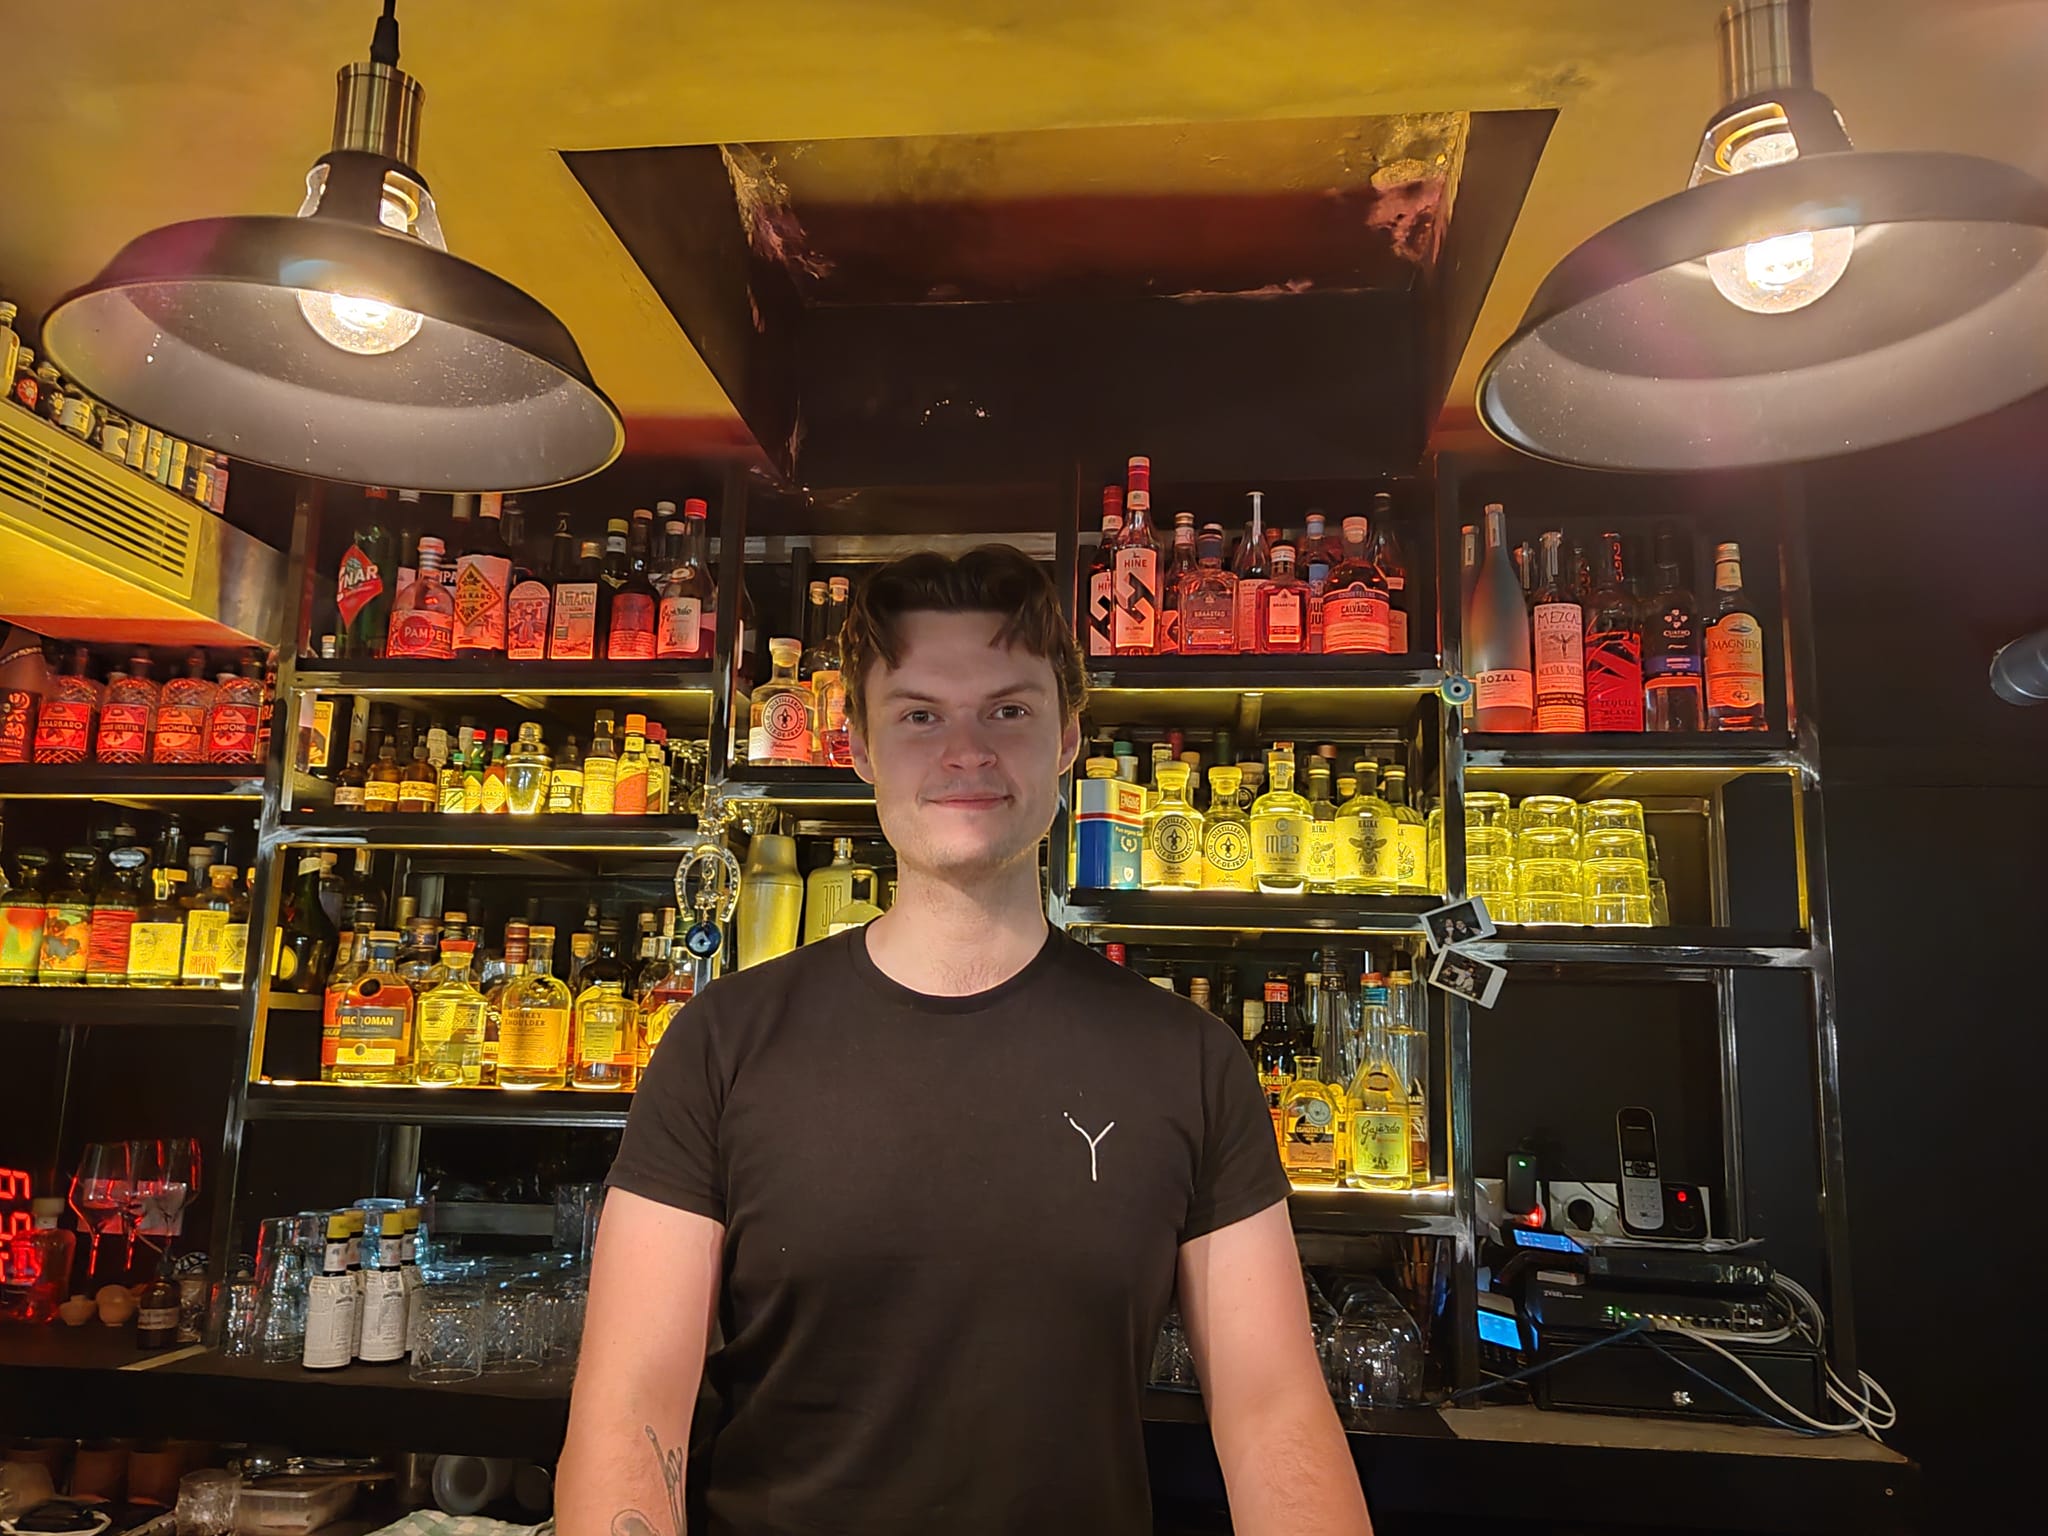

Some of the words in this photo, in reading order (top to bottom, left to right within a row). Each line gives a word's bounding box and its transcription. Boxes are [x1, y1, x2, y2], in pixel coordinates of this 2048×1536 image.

[1124, 560, 1147, 568] HINE
[1341, 604, 1374, 614] CALVADOS
[1538, 610, 1581, 626] MEZCAL
[1480, 674, 1516, 684] BOZAL
[1158, 818, 1191, 832] DISTILLERIE
[1212, 826, 1245, 839] DISTILLERIE
